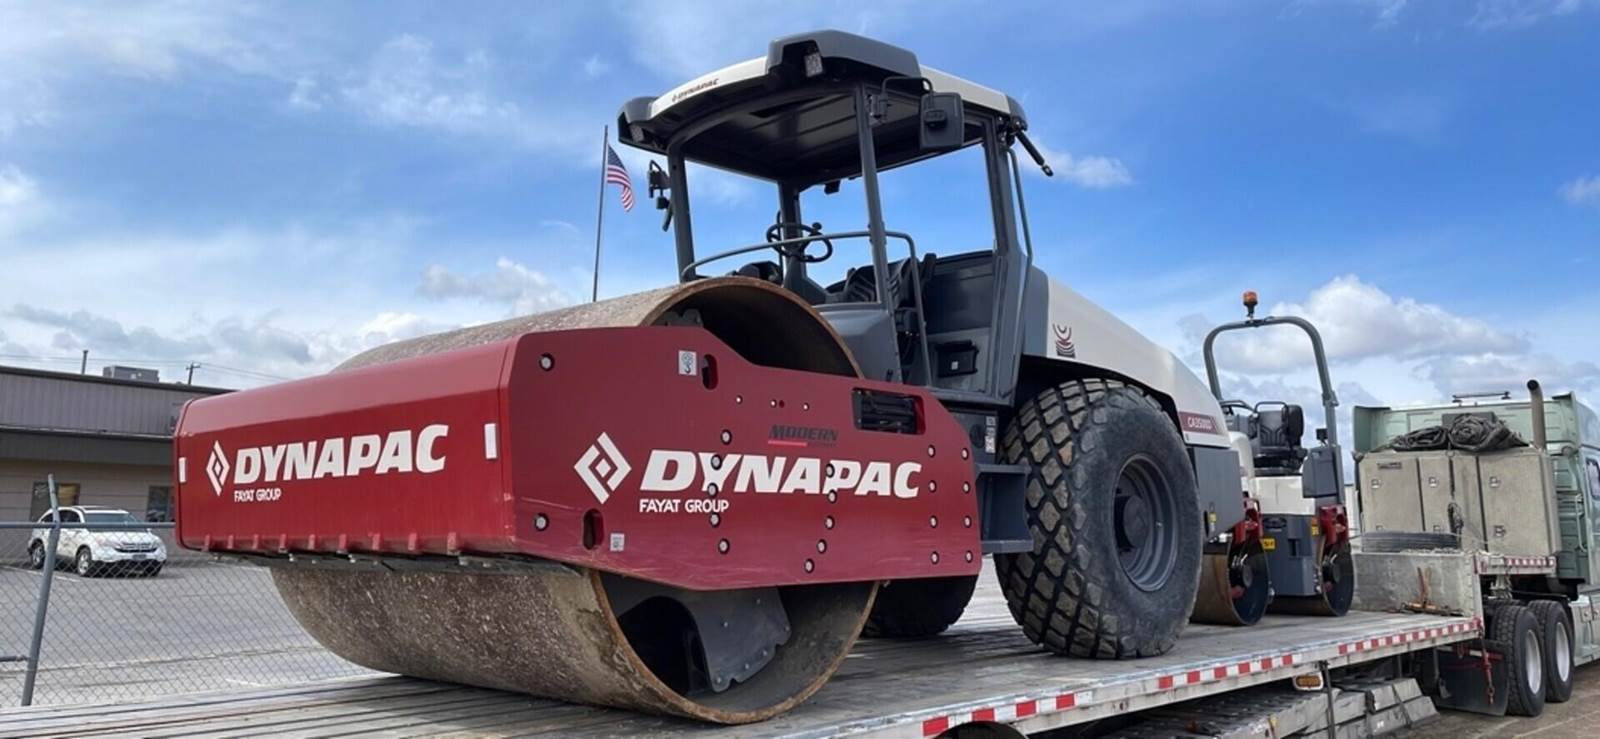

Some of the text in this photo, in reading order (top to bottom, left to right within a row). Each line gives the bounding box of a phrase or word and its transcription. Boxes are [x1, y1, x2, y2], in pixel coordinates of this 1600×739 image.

[768, 424, 838, 441] MODERN
[234, 424, 449, 484] DYNAPAC
[640, 449, 922, 499] DYNAPAC
[234, 488, 281, 502] FAYAT GROUP
[640, 499, 729, 513] FAYAT GROUP
